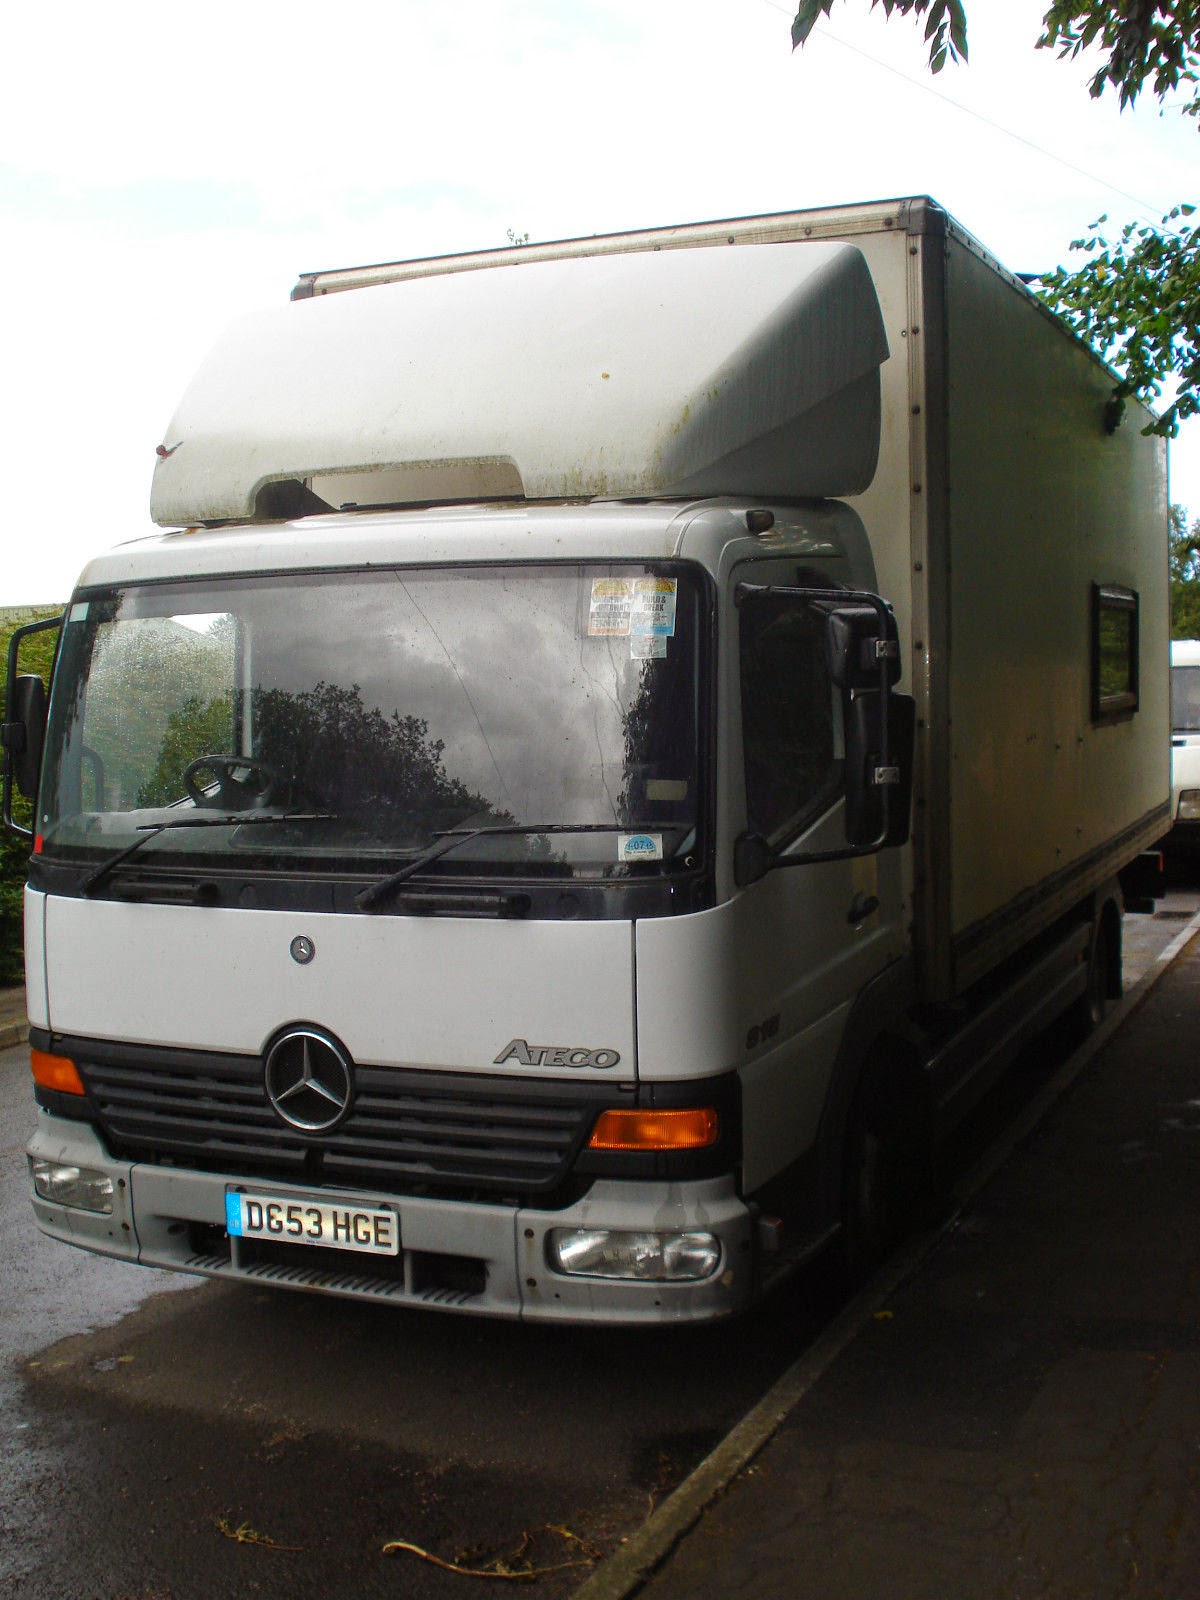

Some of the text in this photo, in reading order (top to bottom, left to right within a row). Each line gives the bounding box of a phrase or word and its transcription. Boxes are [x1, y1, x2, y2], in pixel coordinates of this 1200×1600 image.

[493, 1039, 621, 1069] ATEGO
[246, 1200, 392, 1248] DG53 HGE
